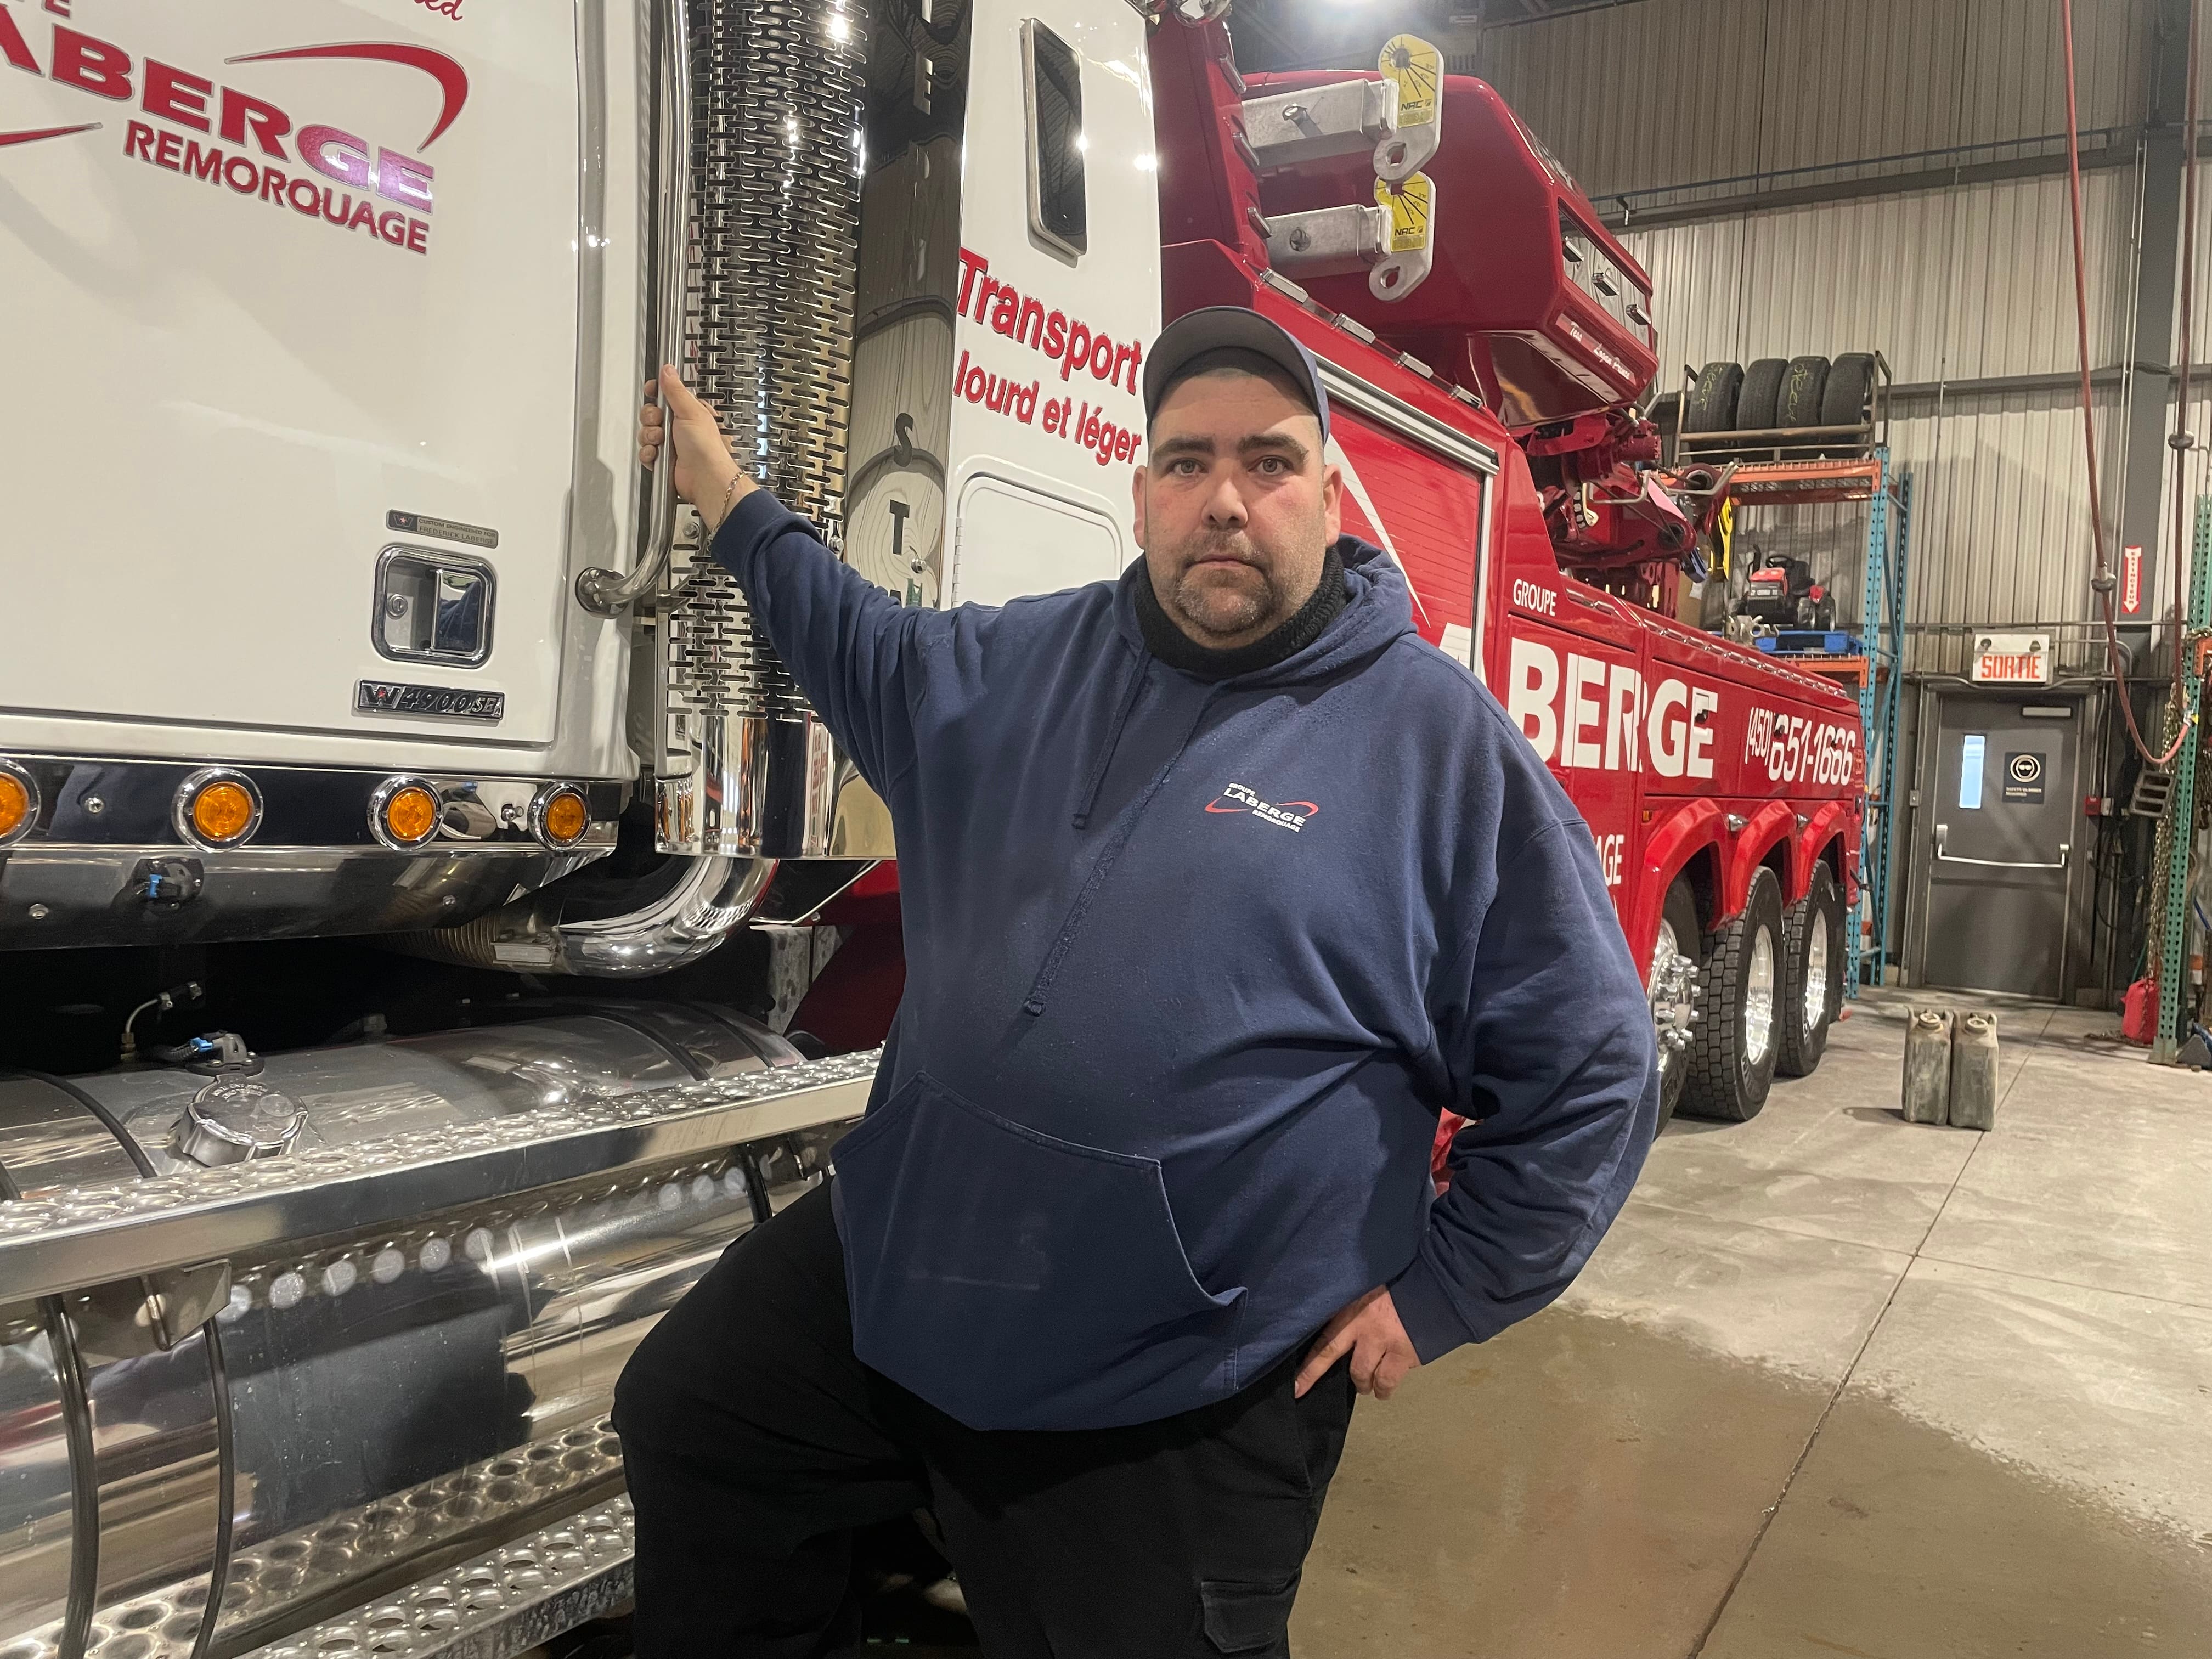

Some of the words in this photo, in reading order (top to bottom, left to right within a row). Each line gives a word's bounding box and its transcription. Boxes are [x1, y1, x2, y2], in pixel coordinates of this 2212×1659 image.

[1400, 100, 1424, 111] NRC
[122, 119, 430, 255] REMORQUAGE
[1394, 227, 1415, 236] NRC
[957, 247, 1143, 396] Transport
[953, 350, 1039, 424] lourd
[1042, 396, 1071, 439] et
[1075, 407, 1142, 466] léger
[418, 518, 445, 528] CUSTOM
[446, 523, 482, 535] ENGINEERED
[419, 526, 461, 539] FREDERICK
[461, 533, 494, 545] LABERGE
[1513, 578, 1558, 617] GROUPE
[1981, 654, 2041, 679] SORTIE
[1228, 782, 1256, 797] GROUPE
[1223, 788, 1307, 827] LABERGE
[1252, 809, 1301, 833] REMORQUAGE
